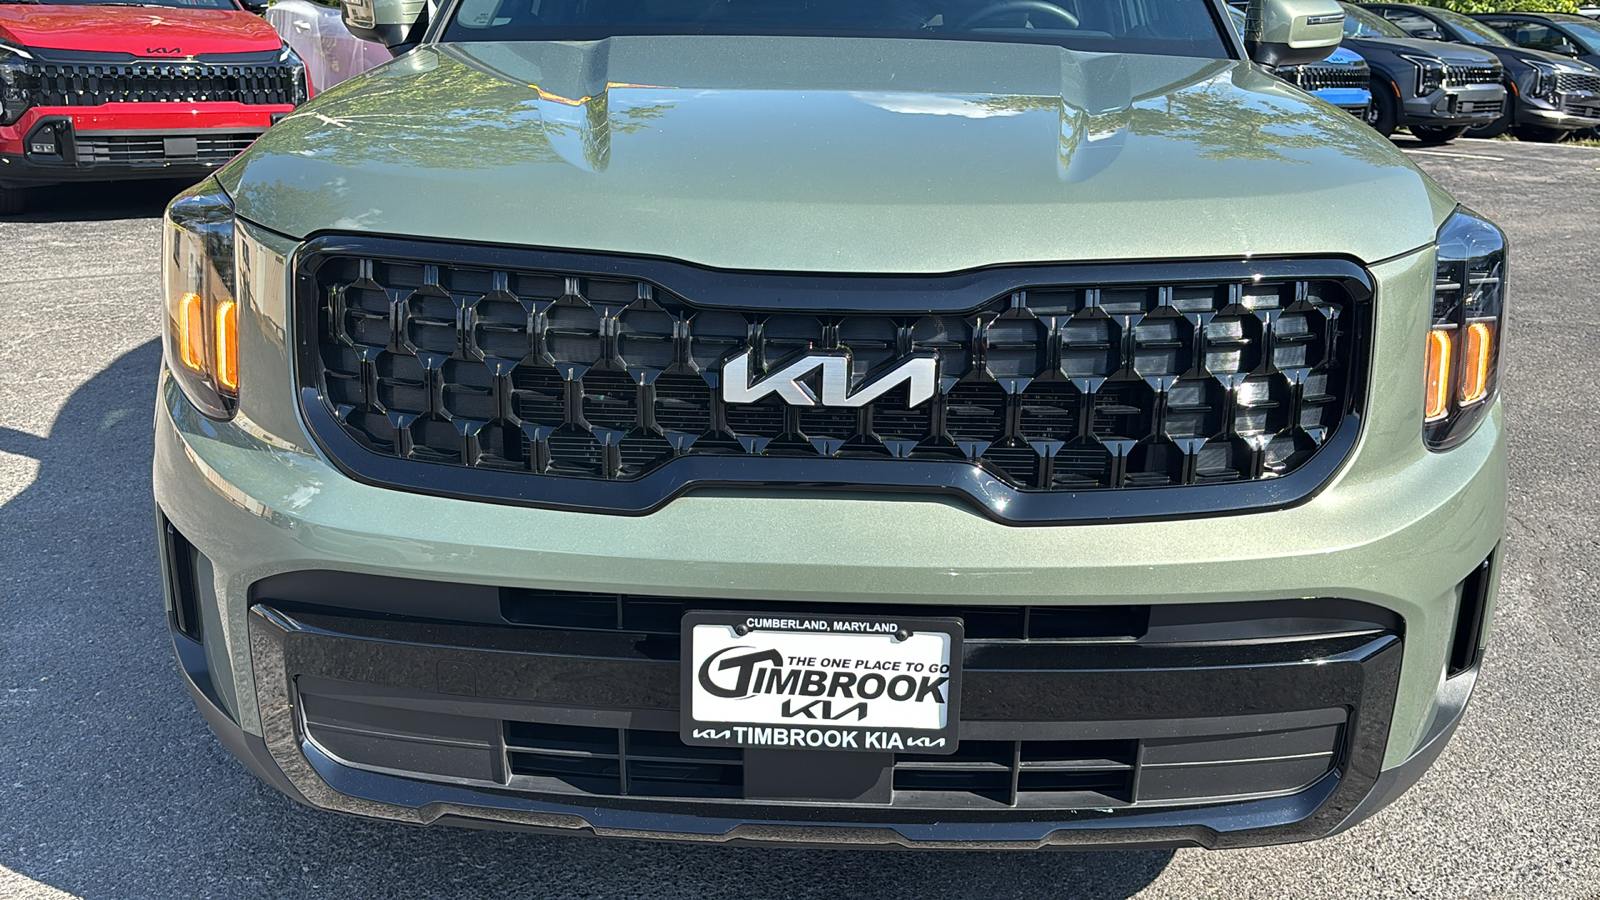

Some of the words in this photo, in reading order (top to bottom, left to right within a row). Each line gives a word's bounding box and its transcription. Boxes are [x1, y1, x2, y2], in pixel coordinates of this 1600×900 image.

[722, 351, 938, 408] KIA
[746, 617, 831, 632] CUMBERLAND,
[833, 620, 898, 633] MARYLAND
[698, 645, 950, 704] TIMBROOK
[787, 656, 817, 667] THE
[820, 657, 852, 669] ONE
[854, 659, 902, 671] PLACE
[905, 662, 925, 673] TO
[928, 663, 950, 674] GO
[781, 699, 868, 721] KIA
[692, 728, 731, 740] KIA
[733, 726, 859, 749] TIMBROOK
[865, 731, 905, 750] KIA
[907, 736, 946, 748] KIA
